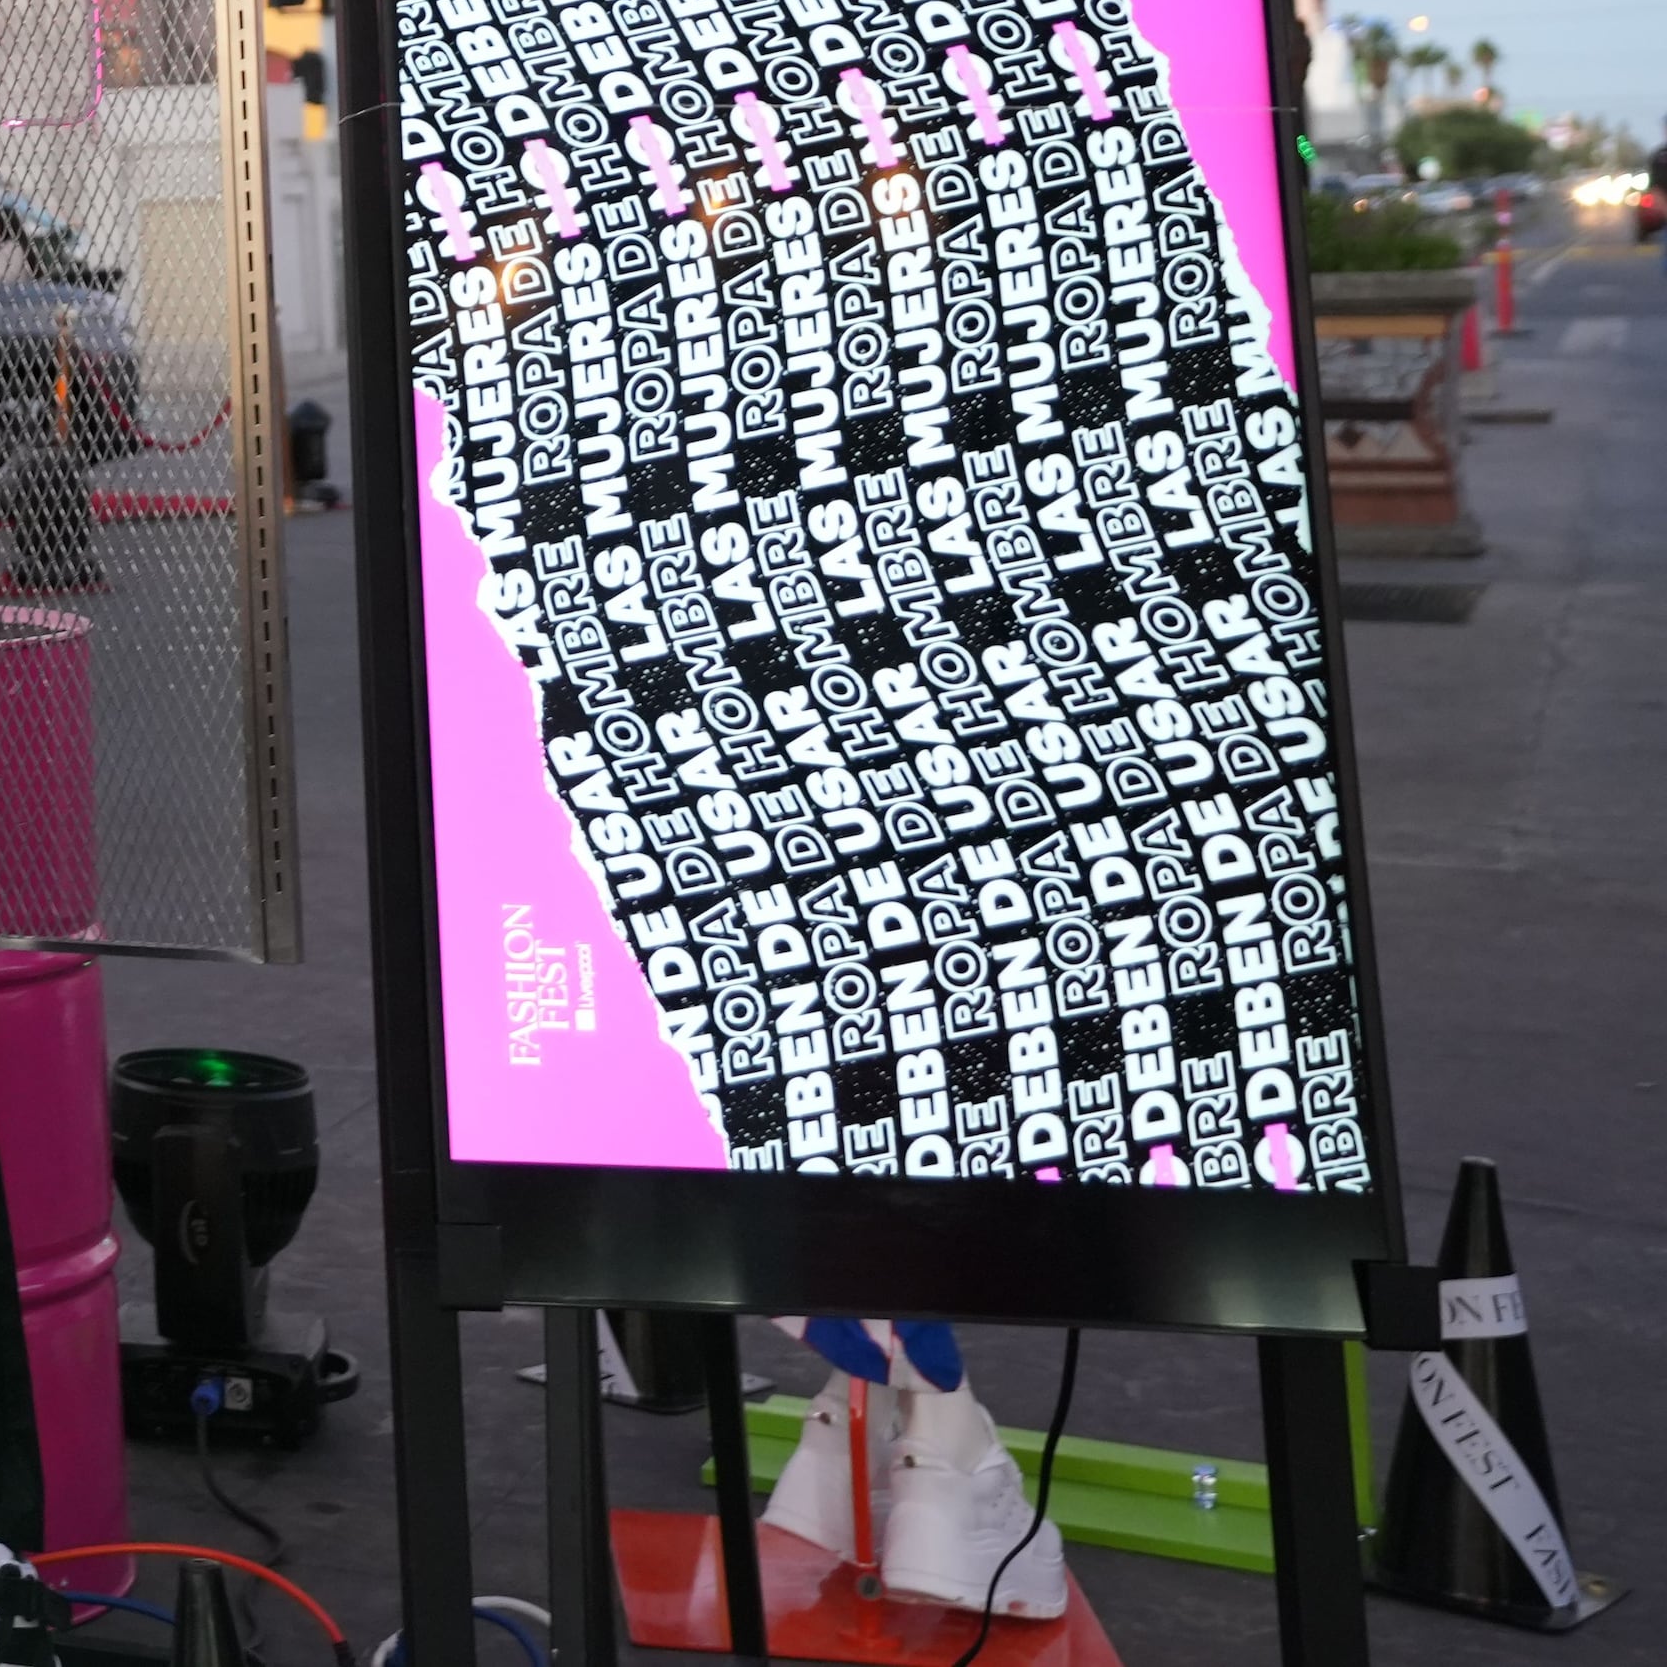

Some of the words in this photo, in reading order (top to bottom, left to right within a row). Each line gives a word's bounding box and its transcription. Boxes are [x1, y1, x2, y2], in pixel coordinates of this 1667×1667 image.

[697, 172, 764, 258] DE
[803, 148, 871, 235] DE
[910, 125, 978, 212] DE
[1017, 102, 1086, 188] DE
[487, 218, 553, 304] DE
[592, 195, 659, 281] DE
[872, 173, 955, 466] MUJERES
[936, 214, 1001, 393] ROPA
[979, 150, 1064, 443] MUJERES
[1044, 190, 1110, 372] ROPA
[1087, 127, 1174, 422] MUJERES
[1153, 165, 1220, 347] ROPA
[450, 267, 526, 559] MUJERES
[511, 306, 572, 485] ROPA
[554, 243, 632, 536] MUJERES
[617, 283, 679, 462] ROPA
[660, 220, 739, 512] MUJERES
[723, 260, 786, 439] ROPA
[763, 197, 847, 490] MUJERES
[829, 237, 893, 418] ROPA
[808, 500, 885, 616] LAS
[916, 477, 993, 593] LAS
[1025, 454, 1103, 570] LAS
[1072, 421, 1227, 690] HOMBRE
[1135, 431, 1214, 547] LAS
[594, 546, 670, 662] LAS
[640, 512, 787, 780] HOMBRE
[701, 523, 776, 640] LAS
[745, 490, 896, 758] HOMBRE
[854, 467, 1006, 735] HOMBRE
[963, 443, 1116, 713] HOMBRE
[533, 535, 678, 802] HOMBRE
[873, 663, 992, 837] USAR
[982, 640, 1102, 814] USAR
[1092, 618, 1213, 792] USAR
[1192, 694, 1279, 783] DE
[1203, 595, 1325, 769] USAR
[548, 731, 662, 905] USAR
[656, 708, 771, 882] USAR
[751, 785, 835, 873] DE
[764, 686, 881, 860] USAR
[861, 762, 945, 851] DE
[971, 739, 1056, 828] DE
[1081, 717, 1167, 806] DE
[1182, 793, 1256, 881] DE
[642, 807, 725, 895] DE
[739, 884, 810, 971] DE
[849, 861, 920, 949] DE
[959, 839, 1032, 926] DE
[1019, 831, 1110, 1017] ROPA
[1070, 816, 1143, 905] DE
[1131, 808, 1223, 995] ROPA
[1244, 786, 1336, 972] ROPA
[501, 903, 542, 1066] FASHION
[534, 939, 571, 1030] FEST
[630, 905, 700, 997] DE
[689, 898, 775, 1083] ROPA
[799, 875, 885, 1061] ROPA
[908, 853, 997, 1039] ROPA
[1100, 916, 1181, 1140] DEBEN
[1217, 893, 1296, 1119] DEBEN
[881, 960, 955, 1177] DEBEN
[989, 938, 1068, 1162] DEBEN
